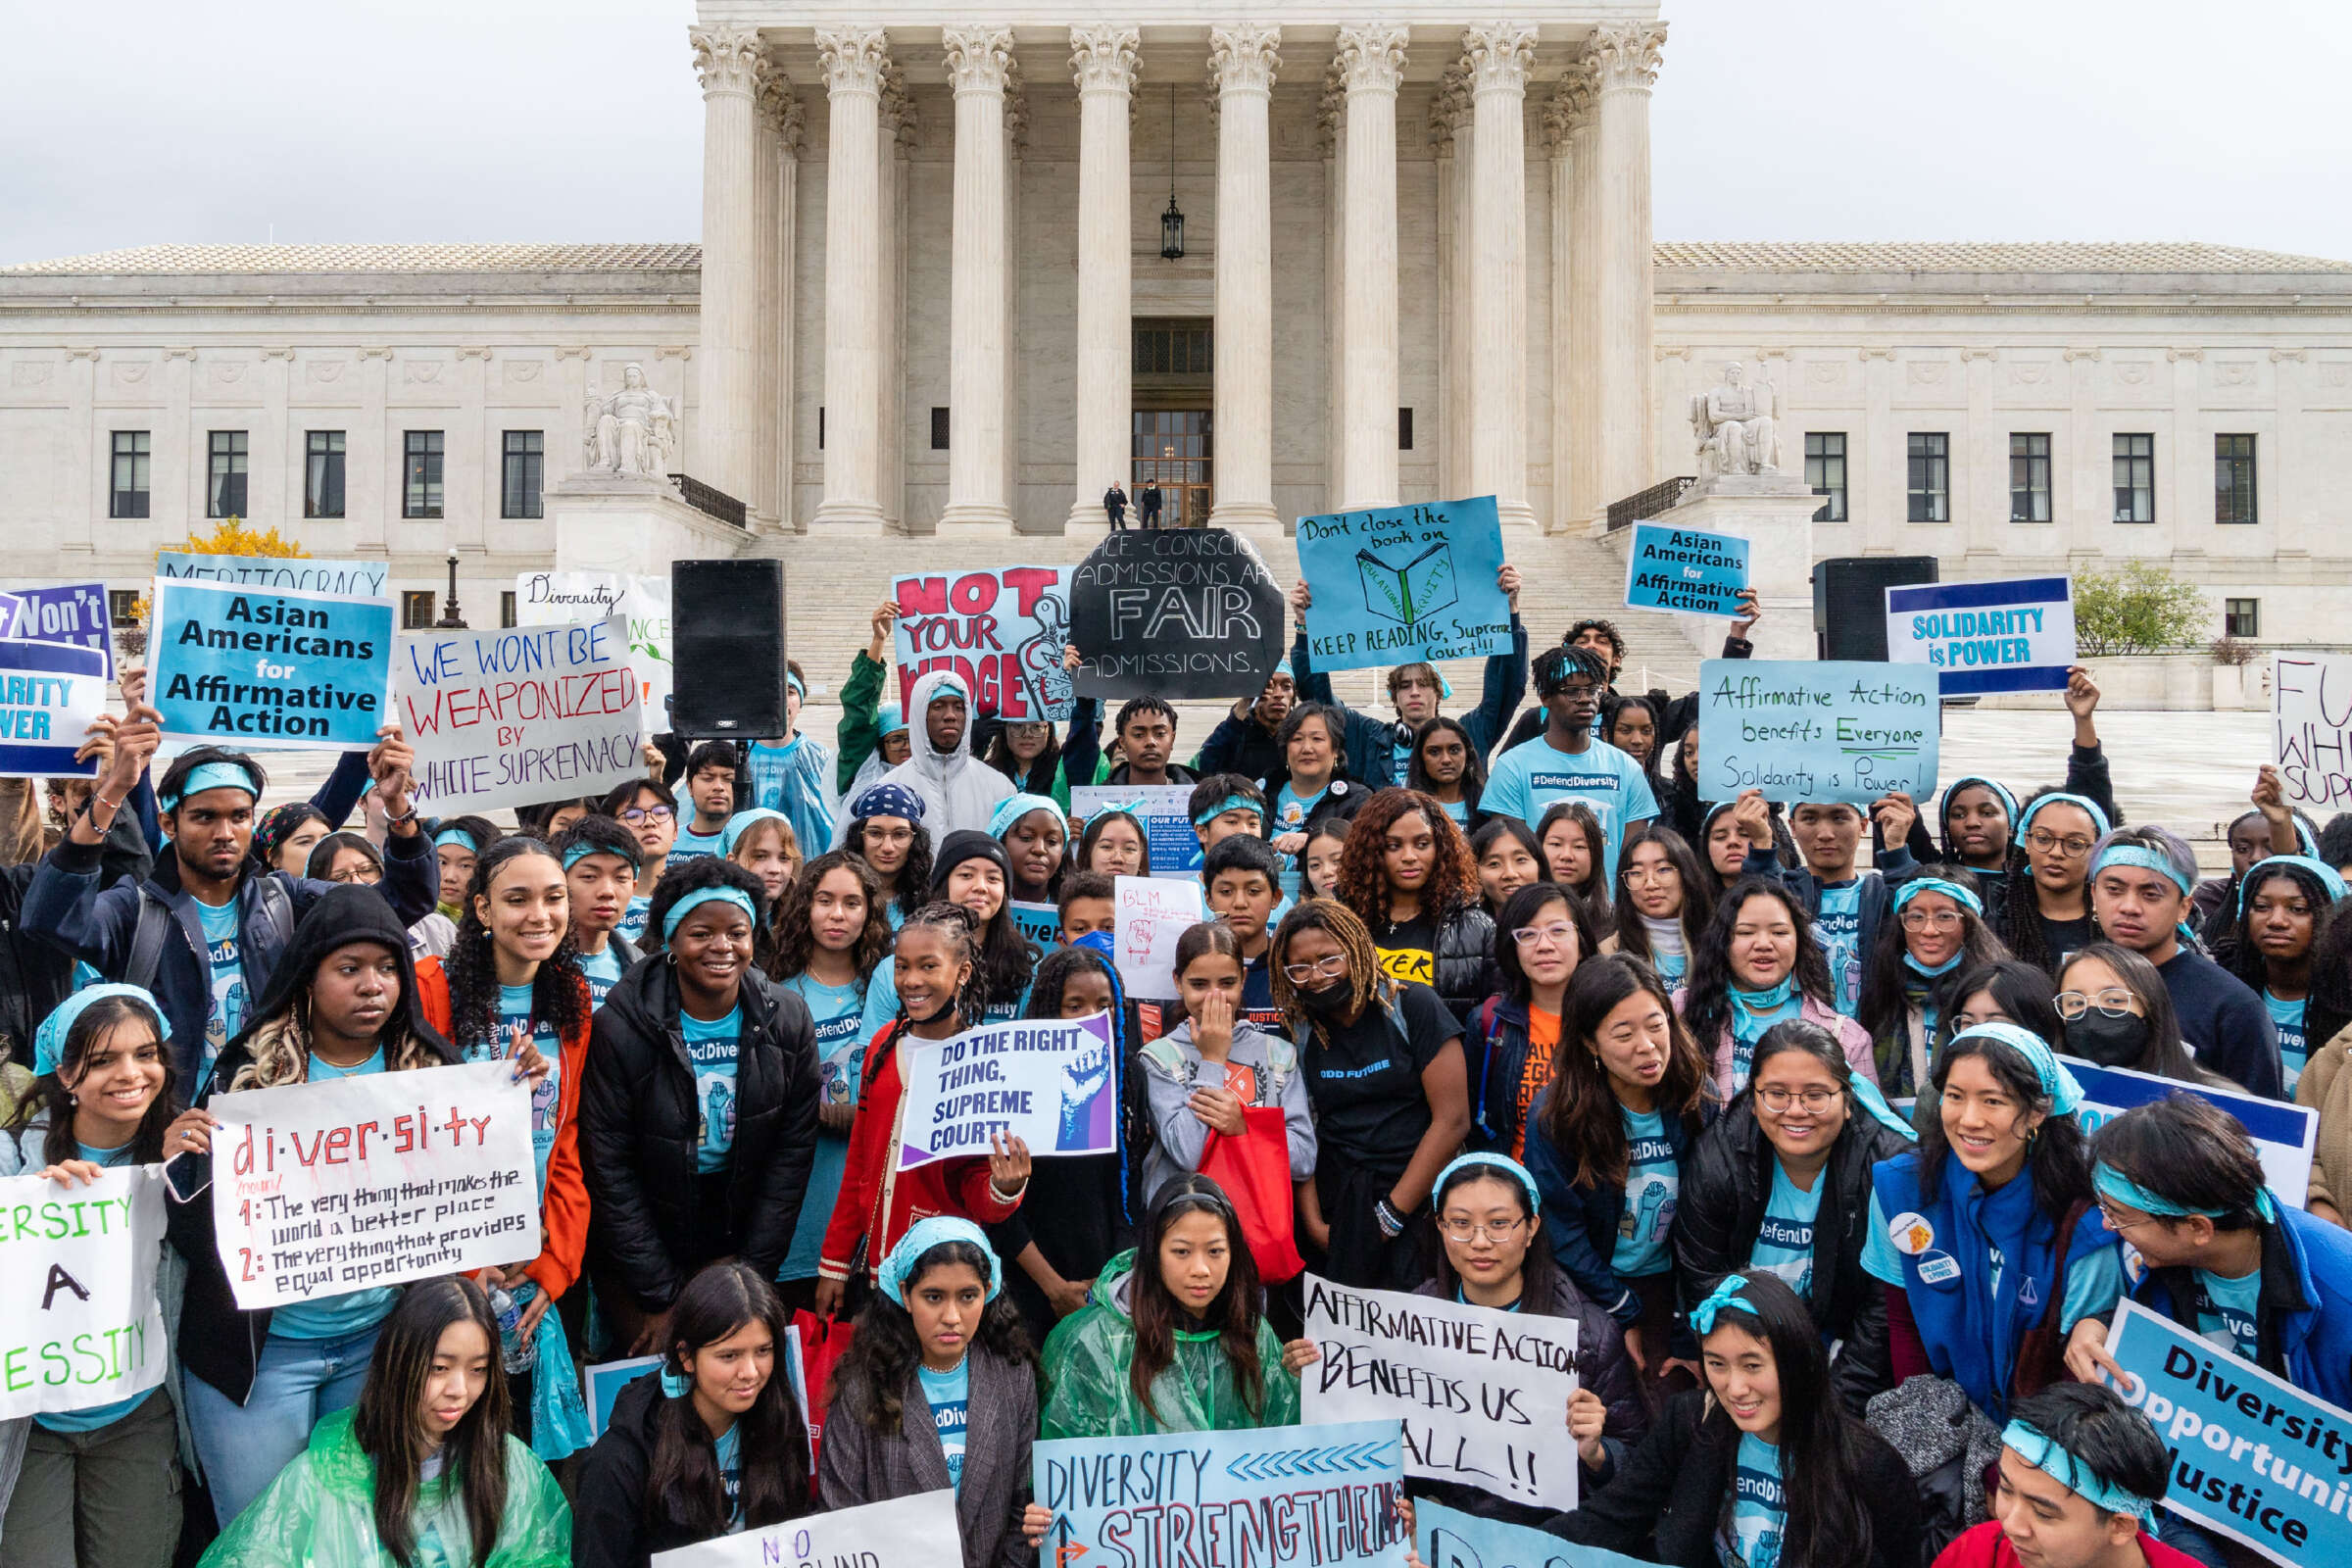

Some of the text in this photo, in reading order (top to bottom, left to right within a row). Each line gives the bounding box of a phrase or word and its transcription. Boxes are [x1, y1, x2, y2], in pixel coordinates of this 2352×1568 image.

[1299, 507, 1450, 540] Don't close the
[1371, 530, 1449, 549] book on
[1642, 544, 1743, 569] Americans
[1669, 531, 1722, 552] Asian
[1076, 562, 1230, 587] ADMISSIONS
[1636, 572, 1744, 598] Affirmative
[1682, 566, 1703, 579] for
[525, 574, 625, 616] Diversity
[896, 567, 1059, 618] NOT
[1656, 591, 1719, 612] Action
[225, 596, 328, 629] Asian
[1110, 585, 1261, 640] FAIR
[1912, 607, 2044, 640] SOLIDARITY
[178, 619, 373, 660] Americans
[903, 613, 1004, 654] YOUR
[1312, 632, 1356, 657] KEEP
[411, 642, 463, 685] WE
[568, 622, 611, 664] BE
[1928, 637, 2031, 667] is POWER
[256, 660, 296, 679] for
[166, 673, 376, 711] Affirmative
[407, 667, 635, 737] WEAPONIZED
[898, 654, 1028, 724] WDGE
[1712, 675, 1926, 709] Affirmative Action
[208, 706, 329, 736] Action
[497, 726, 525, 747] BY
[1741, 717, 1822, 742] benefits
[410, 731, 639, 803] WHITE SUPREMACY
[1533, 775, 1619, 790] #DefendDiversity
[1721, 756, 1814, 796] Solidarity
[1828, 771, 1840, 787] is
[1123, 889, 1160, 907] BLM
[941, 1028, 1082, 1067] DO THE RIGHT
[939, 1059, 1006, 1093] THING,
[1347, 1059, 1391, 1078] FUTURE
[932, 1091, 1033, 1123] SUPREME
[264, 1195, 303, 1220] The
[311, 1193, 348, 1216] very
[354, 1187, 397, 1208] thing
[400, 1179, 434, 1200] that
[438, 1178, 487, 1197] makes
[489, 1169, 522, 1189] the
[271, 1197, 495, 1247] world a better place
[440, 1213, 526, 1248] provides
[41, 1263, 91, 1310] A
[275, 1246, 463, 1296] equal opportunity
[1306, 1282, 1581, 1375] AFFIRMATIVE ACTION
[4, 1315, 145, 1392] ESSITY
[1319, 1340, 1532, 1425] BENEFITS US
[1048, 1448, 1211, 1512] DIVERSITY
[761, 1529, 810, 1566] NO
